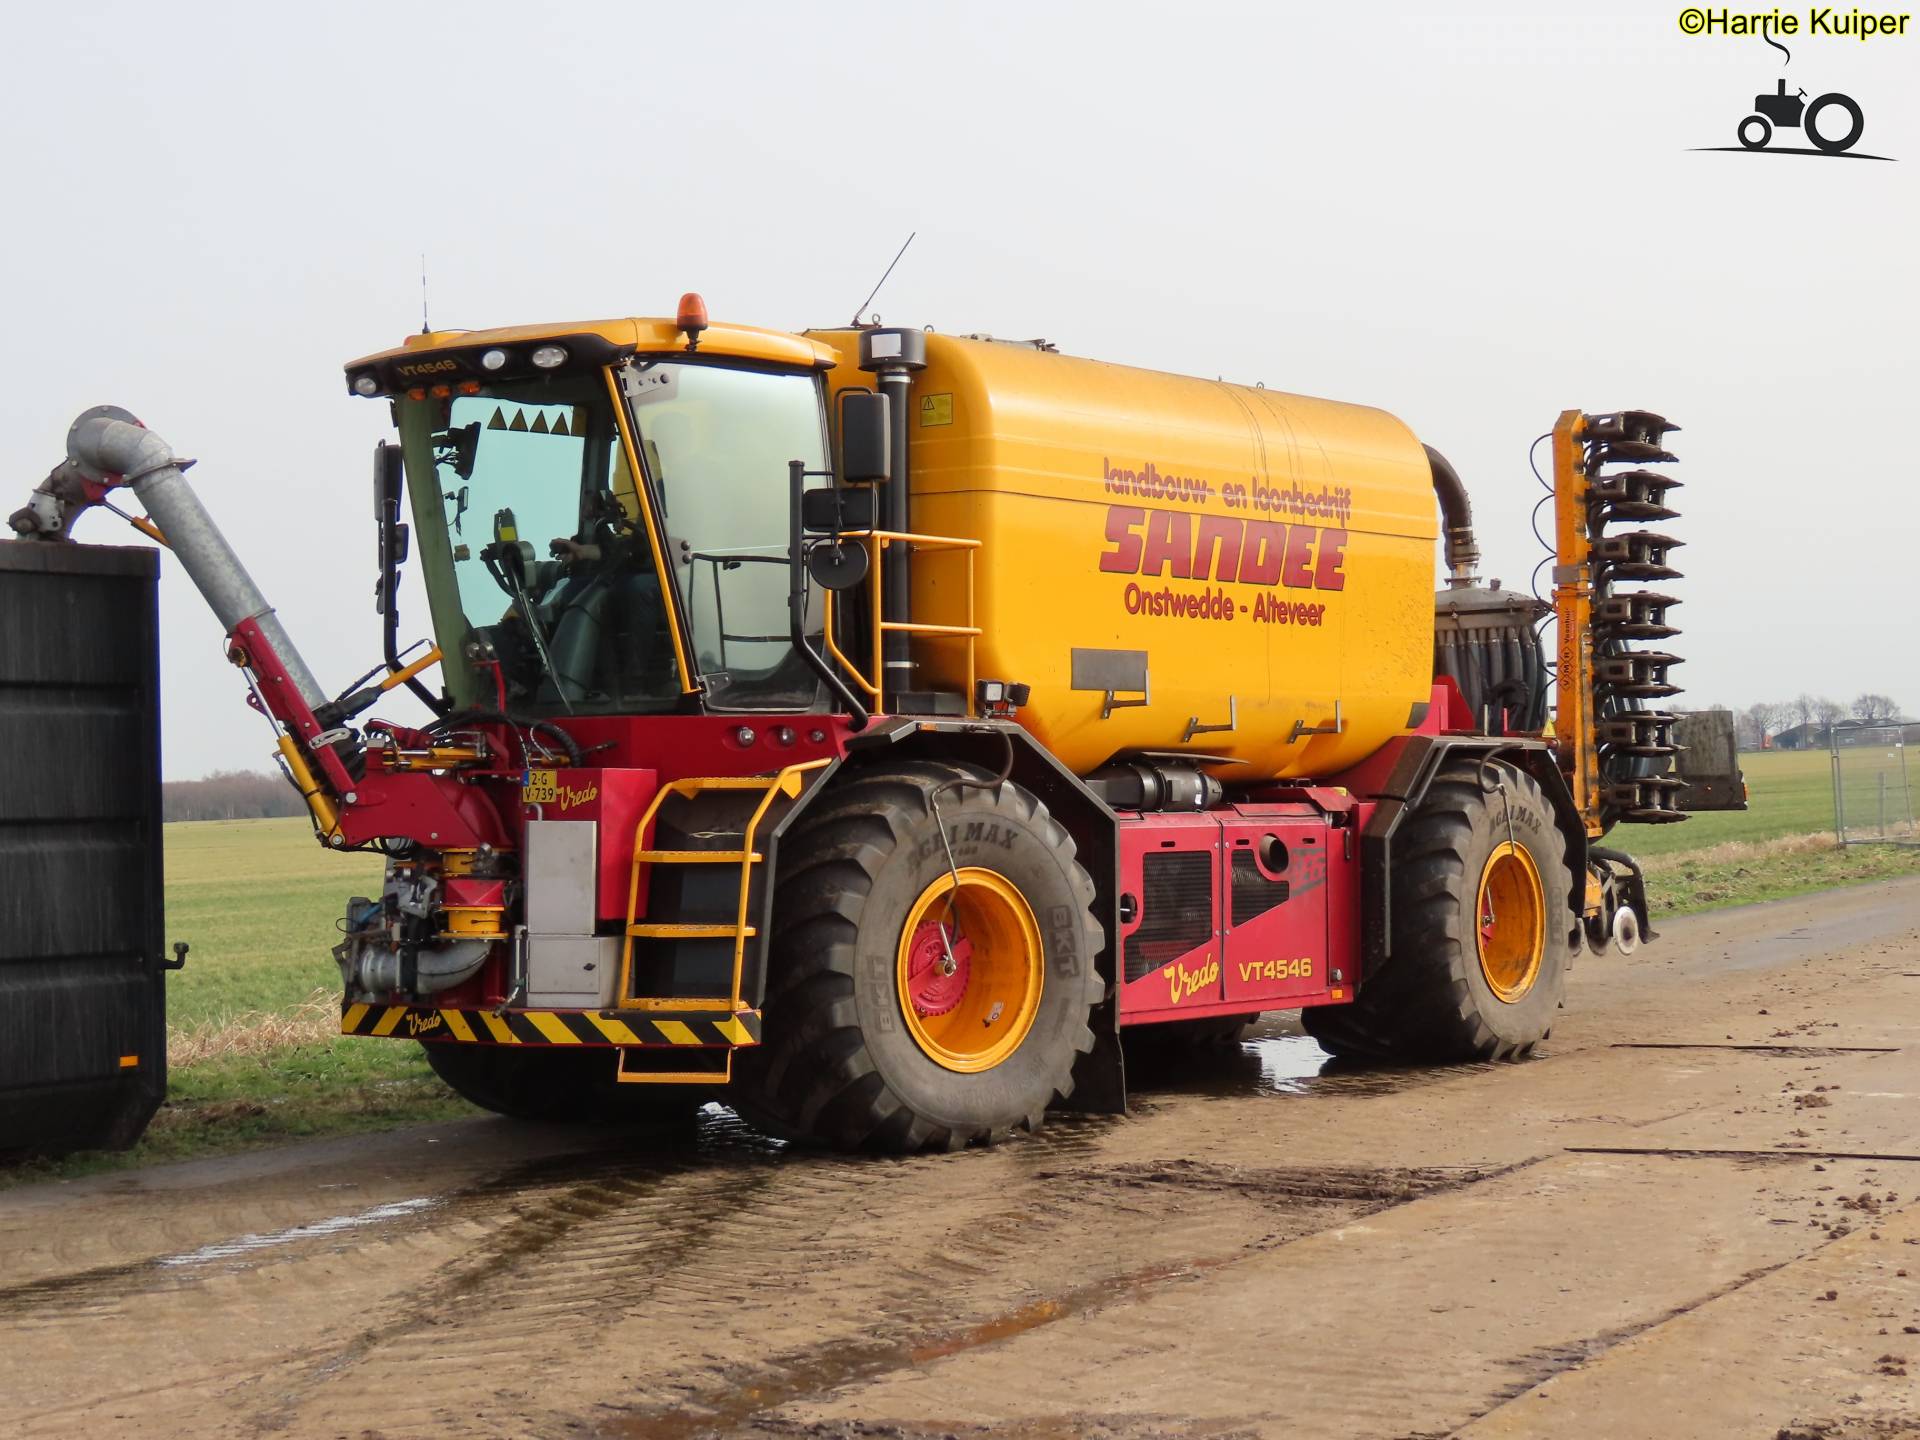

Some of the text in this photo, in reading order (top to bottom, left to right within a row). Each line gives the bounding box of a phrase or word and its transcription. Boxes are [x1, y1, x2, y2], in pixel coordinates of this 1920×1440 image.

[1103, 457, 1352, 528] landbouw- en loonbedrijf
[1099, 504, 1349, 592] SANDEE
[1124, 582, 1234, 622] Onstwedde
[1252, 591, 1326, 627] Alteveer
[556, 780, 598, 811] Vredo
[1163, 952, 1220, 1004] Vredo
[1238, 957, 1313, 983] VT4546
[405, 1009, 442, 1037] Vredo
